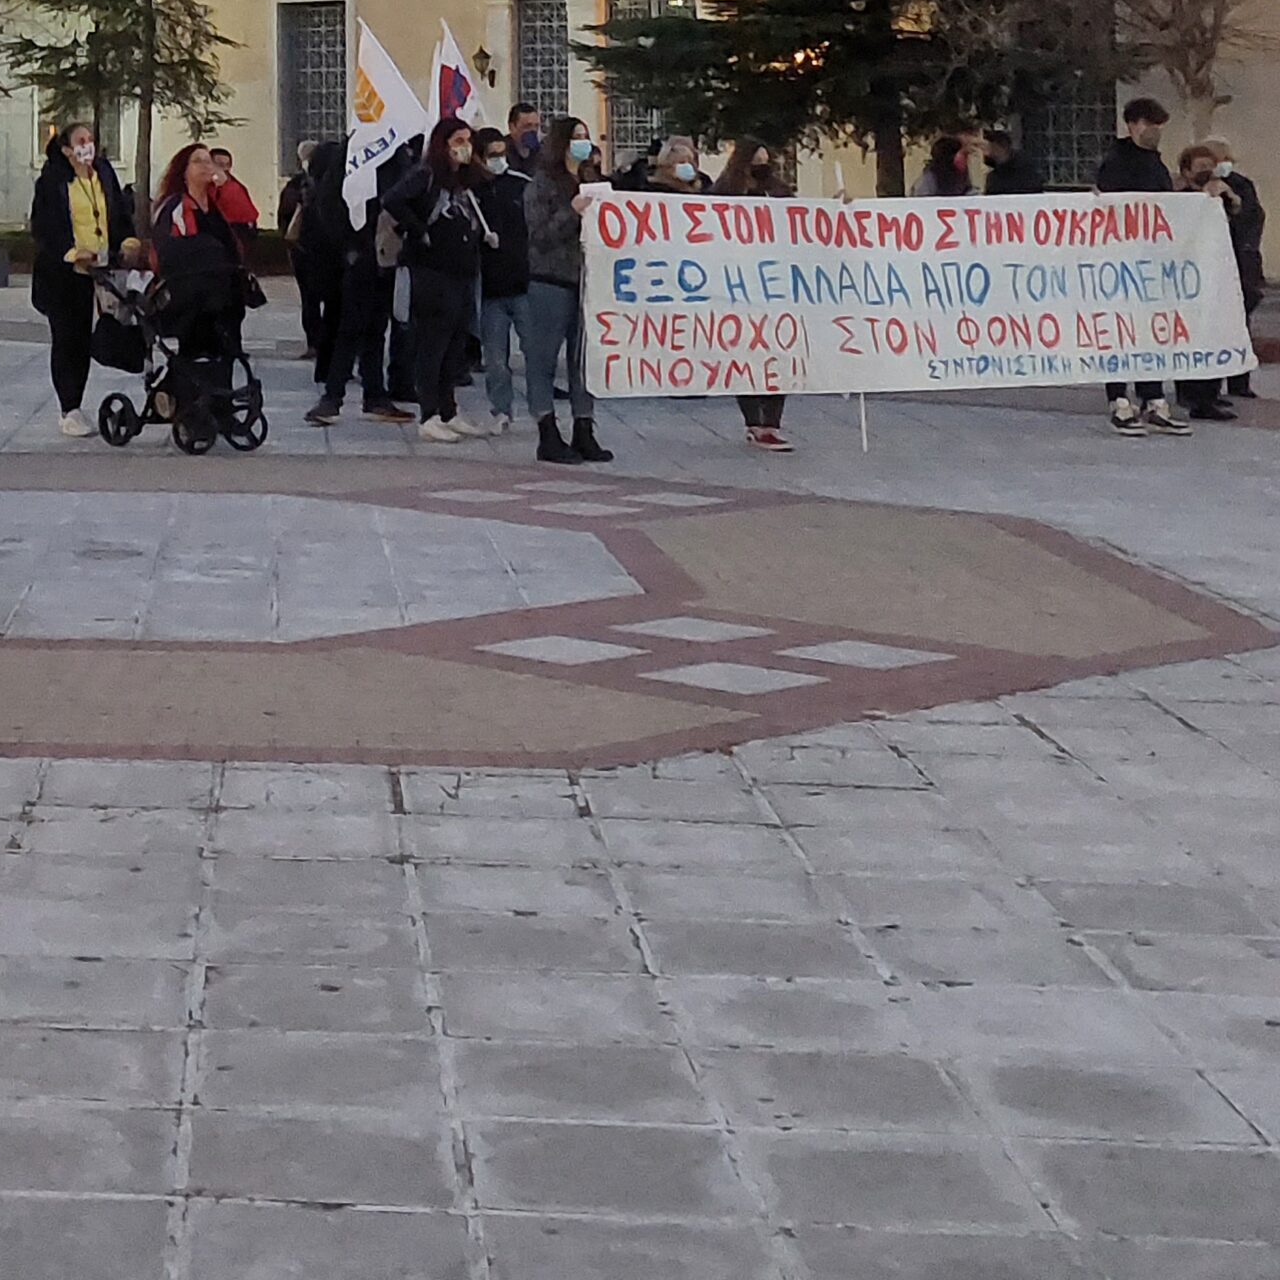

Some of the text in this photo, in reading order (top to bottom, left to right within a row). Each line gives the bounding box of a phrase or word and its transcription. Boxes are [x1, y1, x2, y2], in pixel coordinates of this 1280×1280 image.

[597, 200, 1174, 252] ΟΧΙ ΣΤΟΝ ΠΟΛΕΜΟ ΣΤΗΝ ΟΥΚΡΑΝΙΑ
[723, 263, 750, 304] Η
[757, 259, 912, 307] ΕΛΛΑΔΑ
[921, 260, 991, 312] ΑΠΟ
[1002, 262, 1067, 302] ΤΟΝ
[1077, 259, 1201, 302] ΠΟΛΕΜΟ
[595, 310, 1190, 357] ΣΥΝΕΝΟΧΟΙ ΣΤΟΝ ΦΟΝΟ ΔΕΝ ΘΑ
[928, 354, 1072, 380] ΣΥΝΤΟΝΙΣΤΙΚΗ
[1172, 347, 1247, 371] ΠΥΡΓΟΥ
